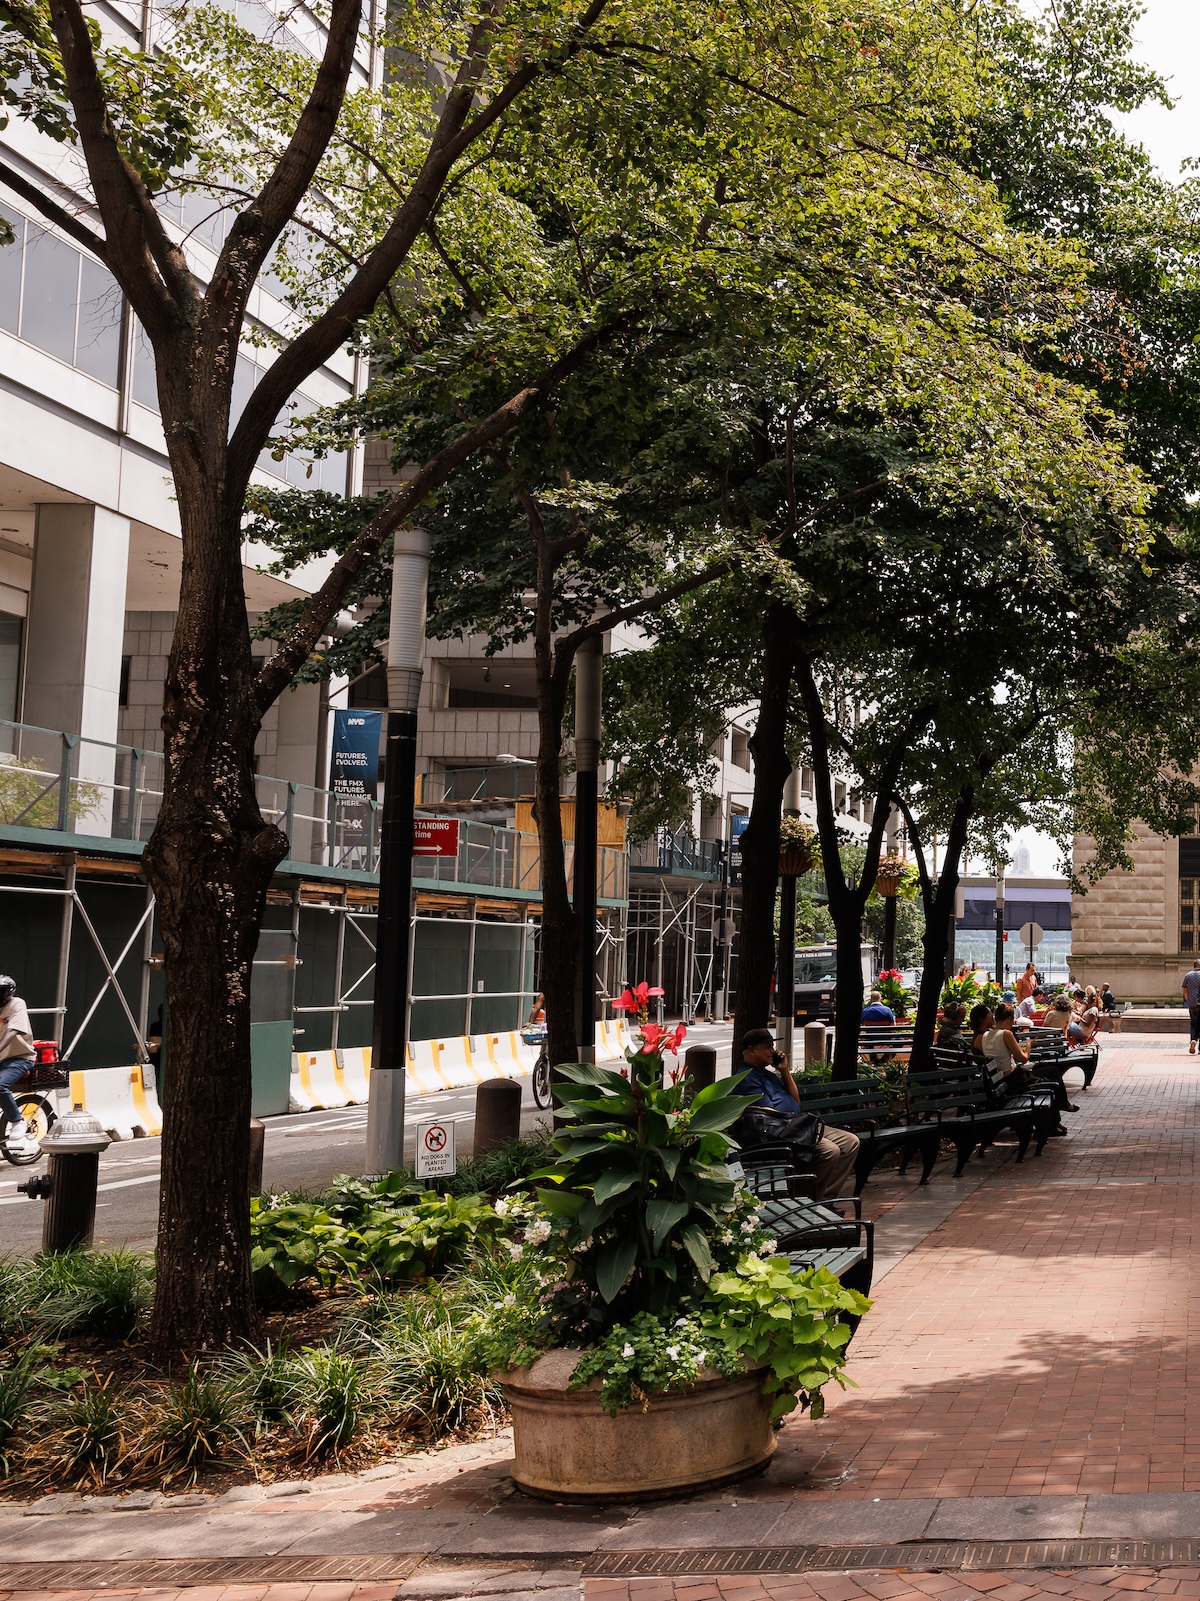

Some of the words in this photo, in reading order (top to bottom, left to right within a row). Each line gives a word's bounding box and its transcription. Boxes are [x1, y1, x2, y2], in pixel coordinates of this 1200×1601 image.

[335, 752, 368, 760] FUTURES,
[413, 821, 450, 830] STANDING
[415, 830, 432, 838] time
